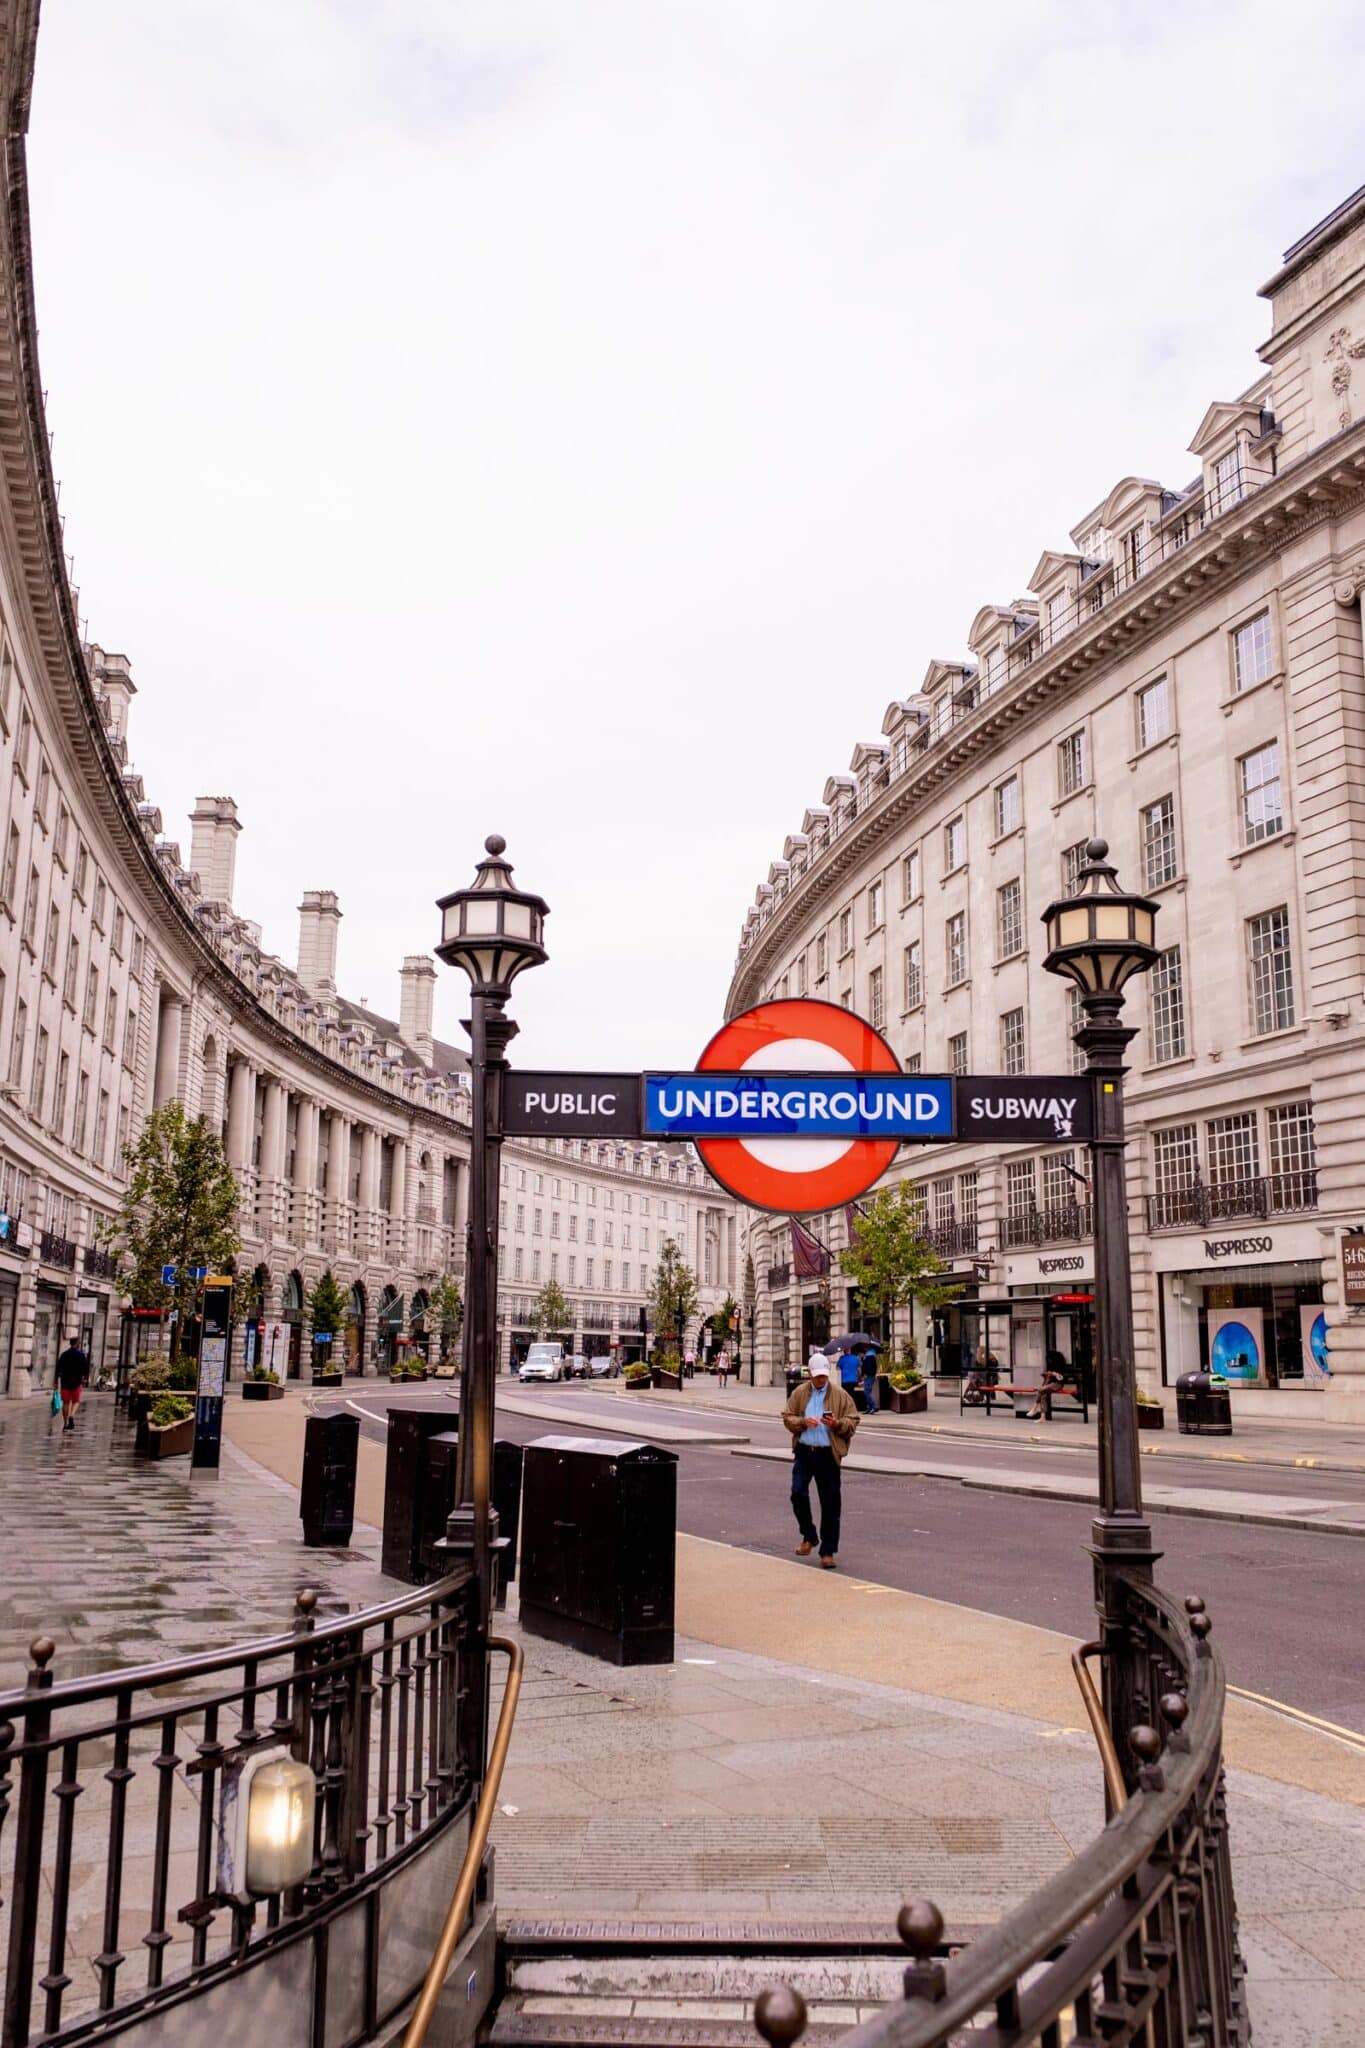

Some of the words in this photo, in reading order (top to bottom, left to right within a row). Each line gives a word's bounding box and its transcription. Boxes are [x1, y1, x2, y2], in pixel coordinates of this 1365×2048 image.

[524, 1091, 616, 1116] PUBLIC
[657, 1089, 940, 1121] UNDERGROUND
[970, 1097, 1077, 1120] SUBWAY
[1202, 1236, 1273, 1260] NESPRESSO
[1344, 1247, 1365, 1264] 54-6
[1038, 1256, 1085, 1276] NESPRESSO
